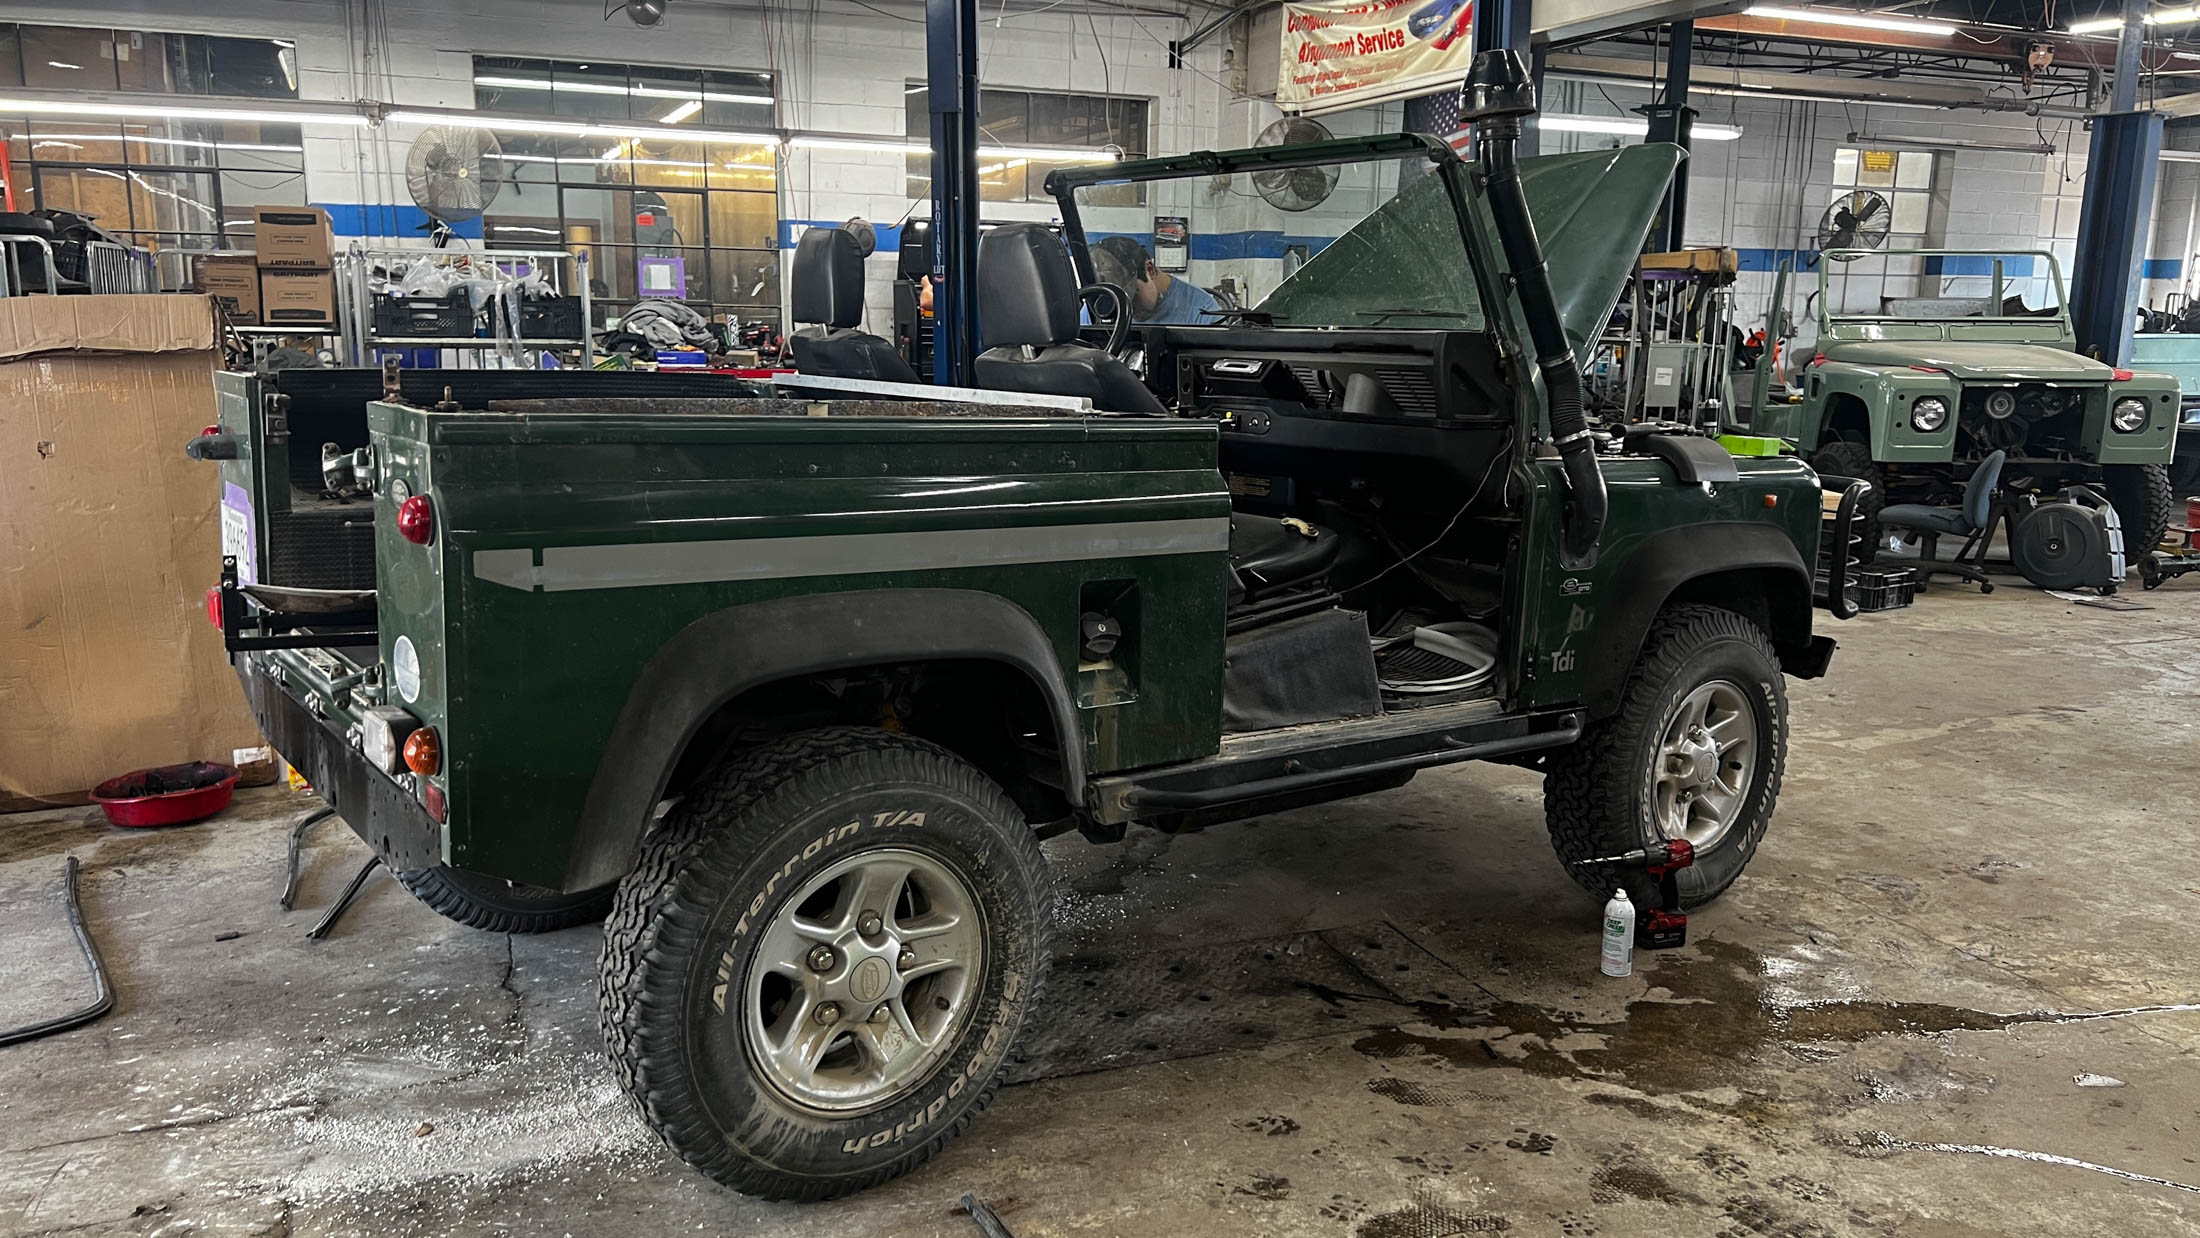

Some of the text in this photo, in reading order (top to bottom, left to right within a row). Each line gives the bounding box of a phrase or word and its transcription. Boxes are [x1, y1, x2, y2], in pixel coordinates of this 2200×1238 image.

[1356, 28, 1405, 56] Service
[933, 265, 945, 274] LIFT
[1551, 649, 1575, 672] Tdi
[1642, 689, 1681, 842] FGoodrich
[1737, 682, 1780, 853] All-Terrain T/A
[713, 810, 926, 1015] All-Terrain T/A
[842, 970, 1018, 1154] BFGoodrich
